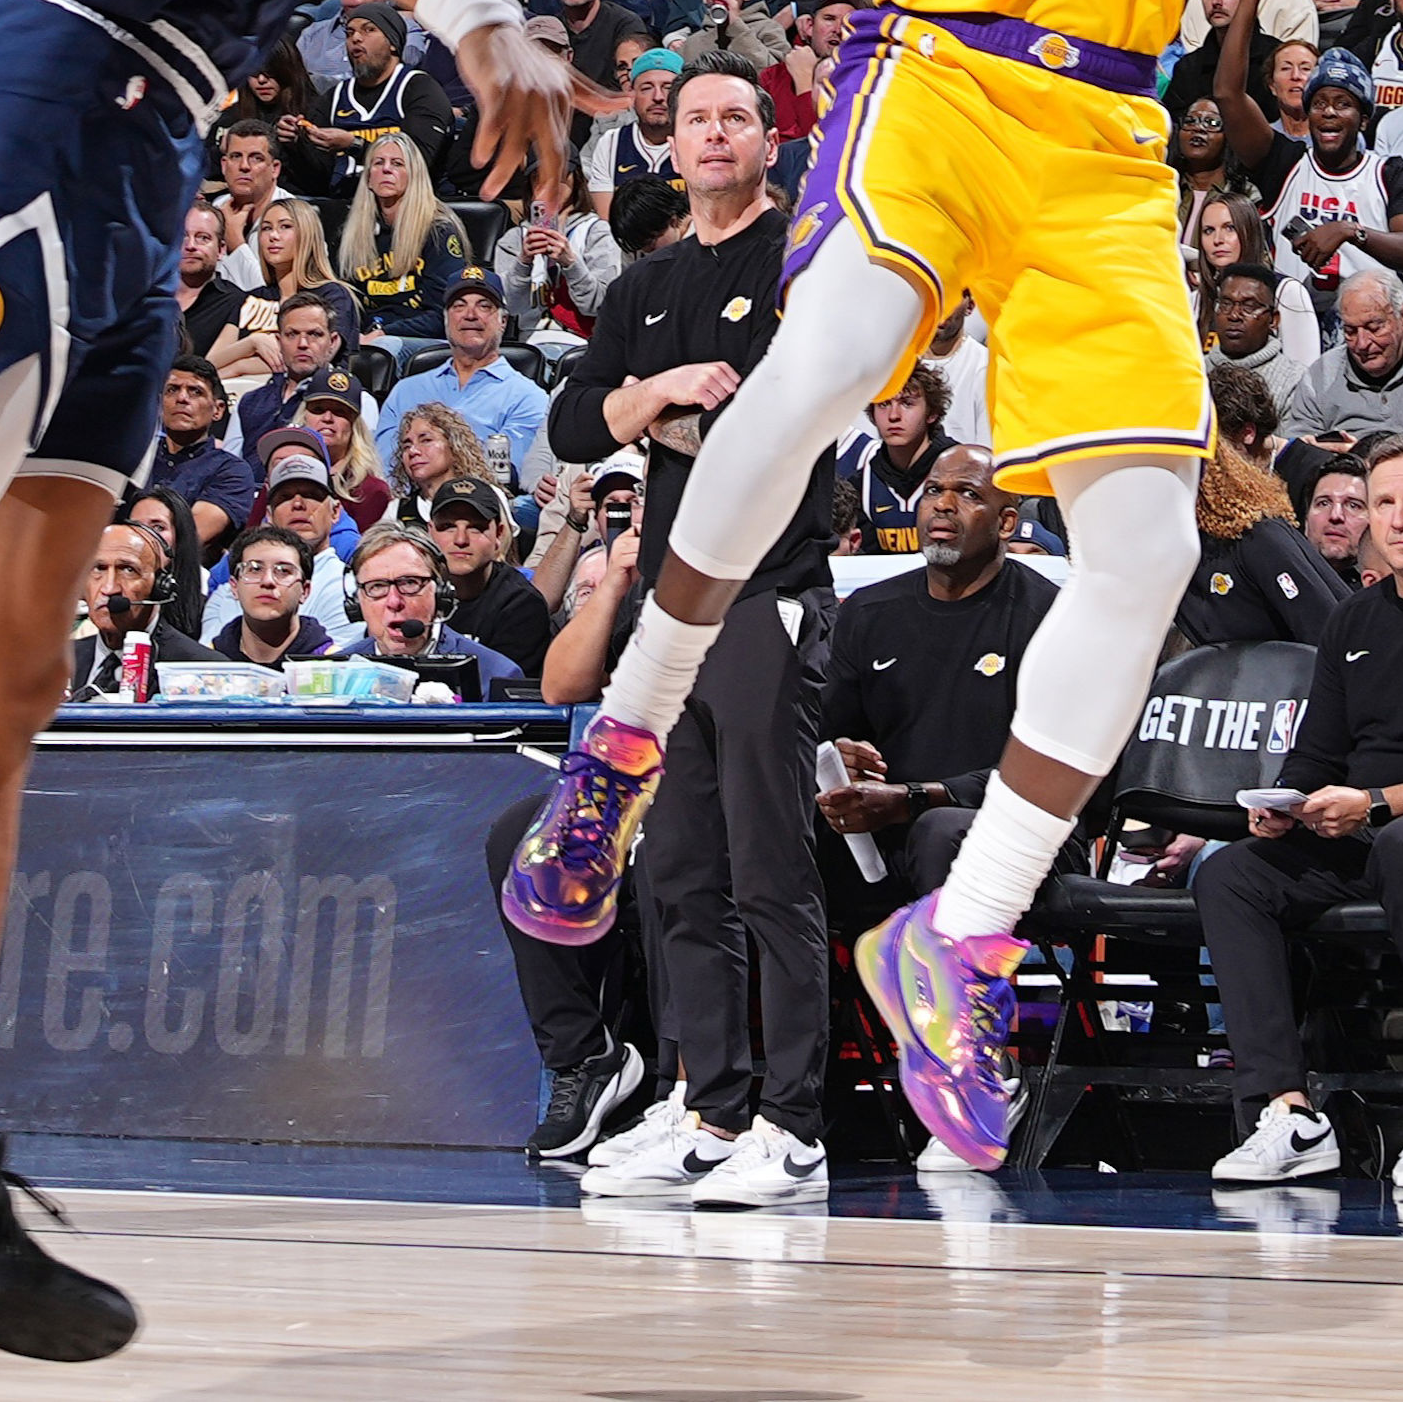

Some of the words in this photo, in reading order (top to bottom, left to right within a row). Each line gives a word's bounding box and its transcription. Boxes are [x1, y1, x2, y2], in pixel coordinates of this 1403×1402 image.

[1300, 193, 1358, 225] USA
[876, 525, 921, 555] DENV
[1139, 696, 1201, 743] GET
[1204, 701, 1266, 751] THE
